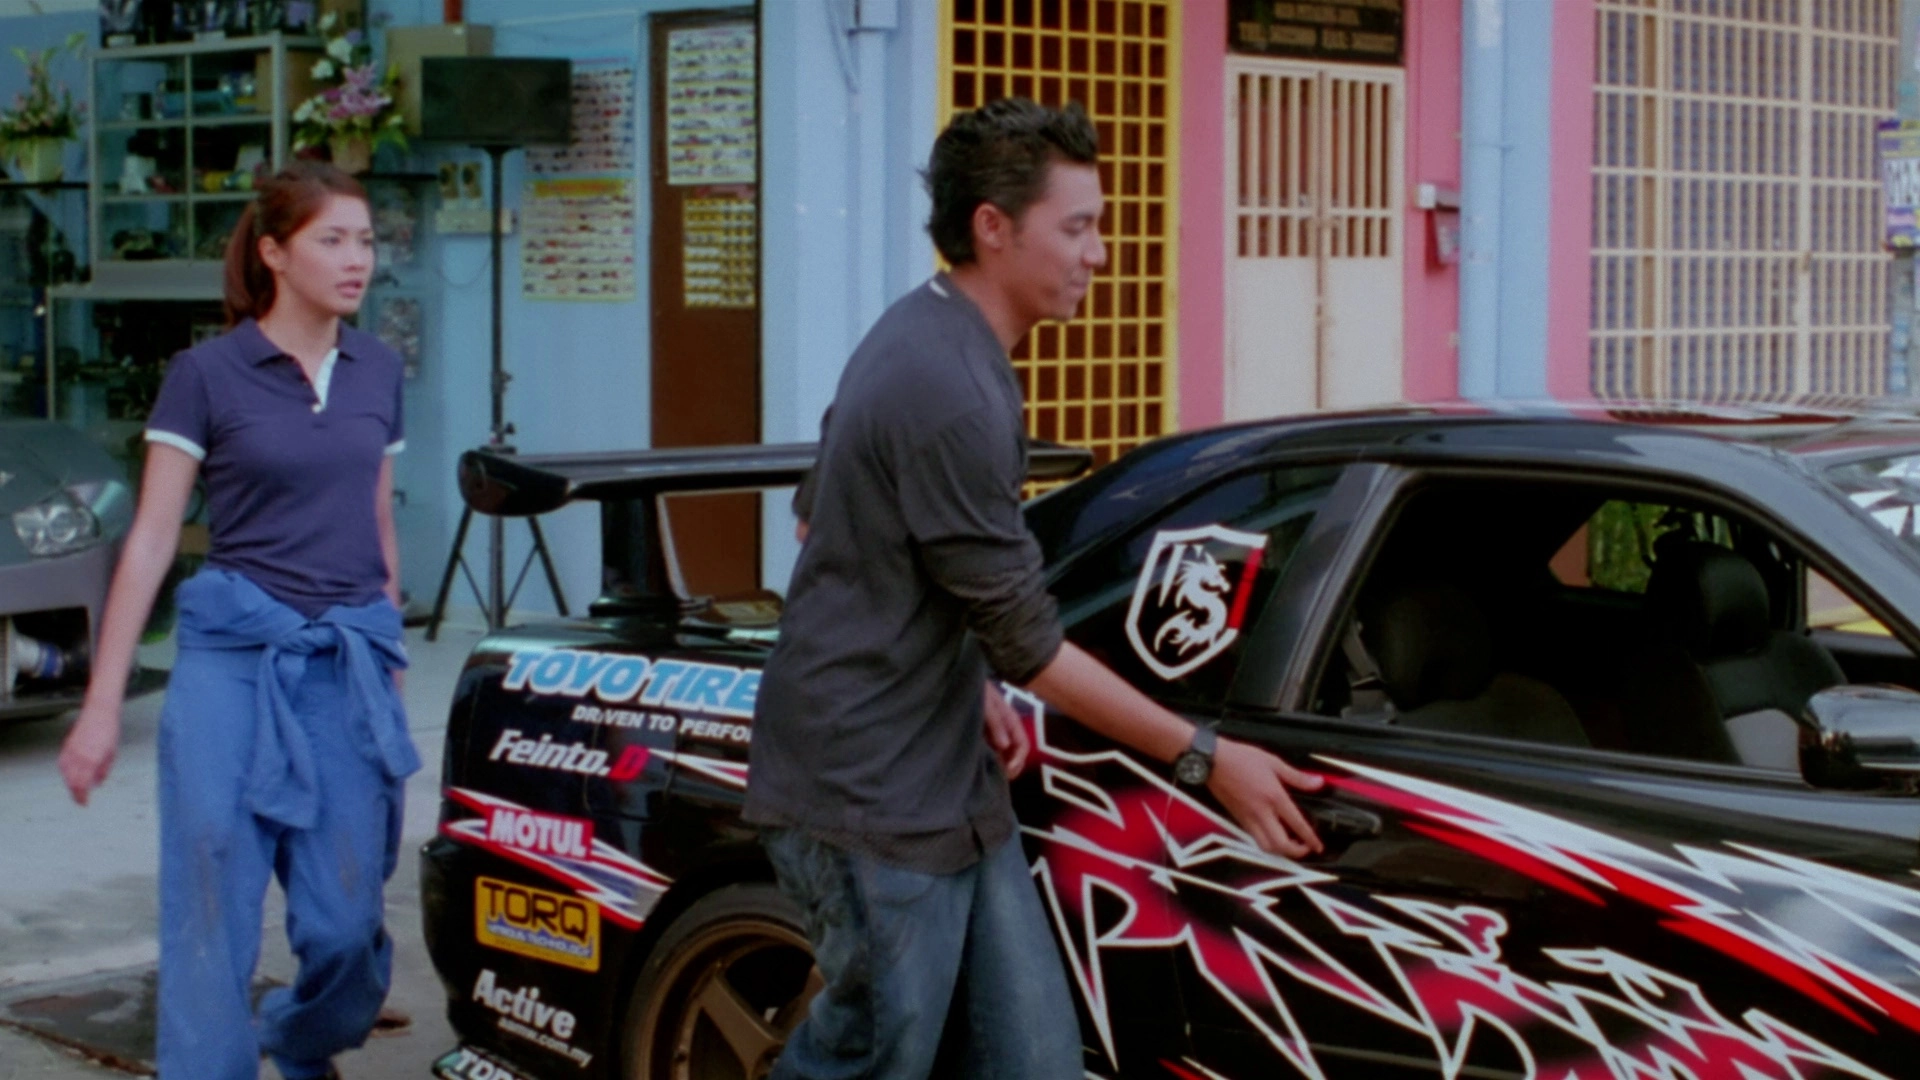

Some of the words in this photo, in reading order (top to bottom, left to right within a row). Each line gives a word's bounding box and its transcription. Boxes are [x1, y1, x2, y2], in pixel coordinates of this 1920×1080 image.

[503, 650, 650, 702] TOYO
[571, 704, 645, 728] DRVEN
[648, 713, 677, 732] TO
[490, 809, 586, 858] MOTUL
[481, 881, 588, 944] TORQ
[473, 968, 577, 1039] Active
